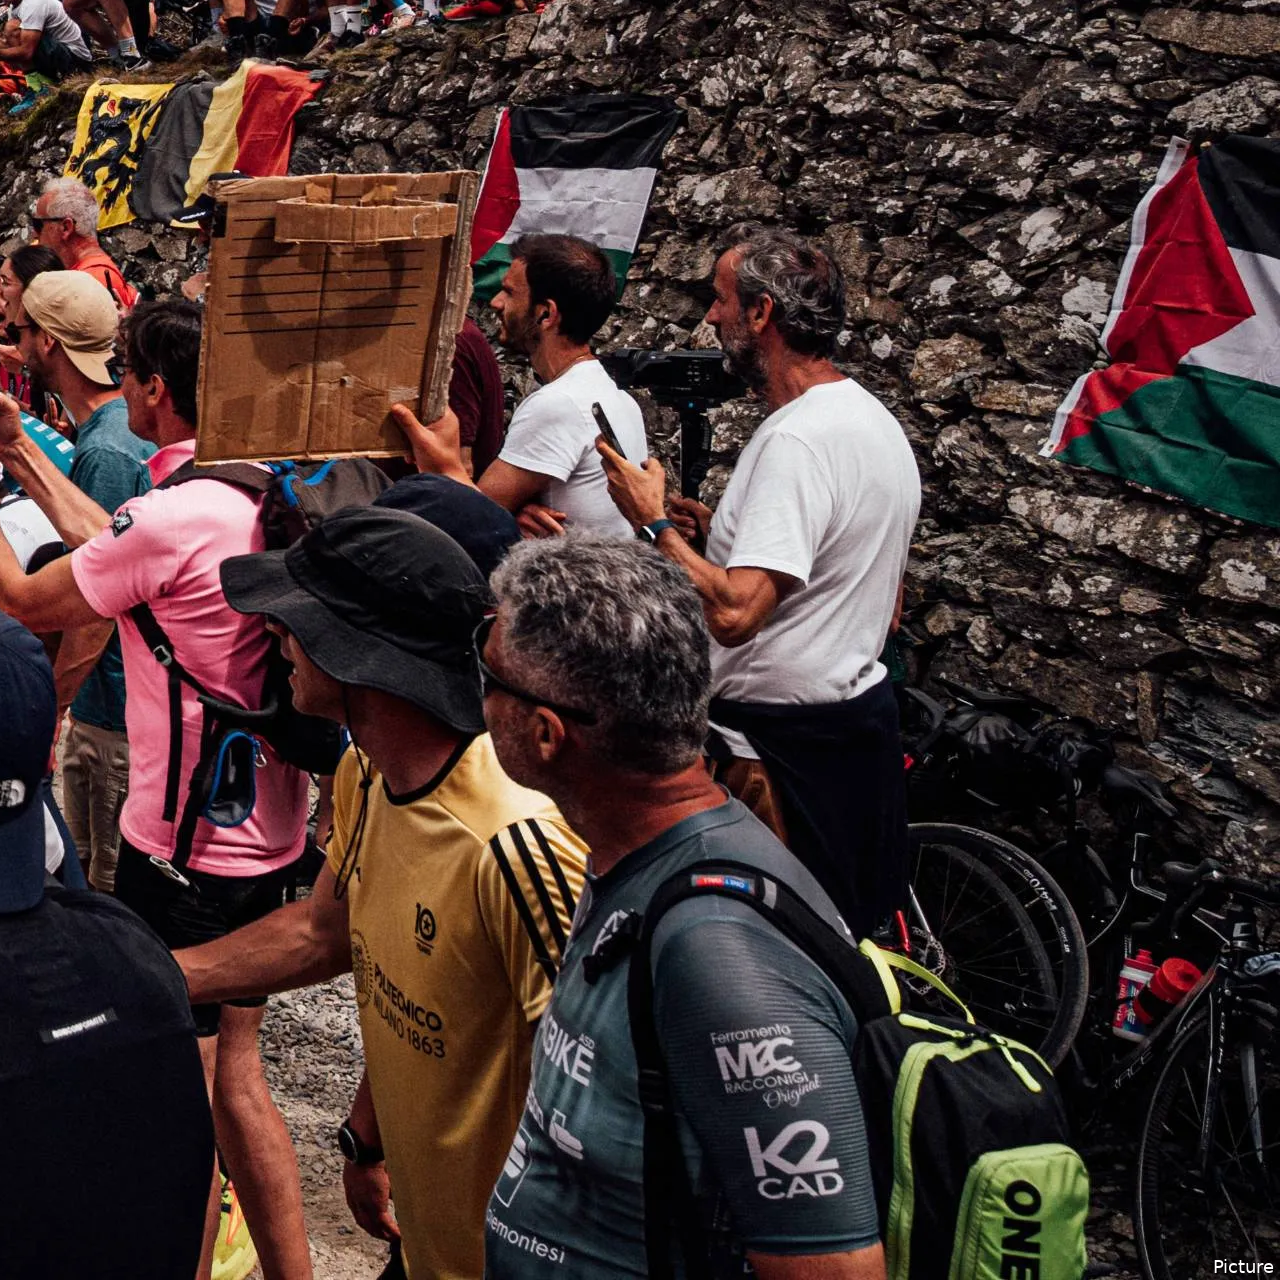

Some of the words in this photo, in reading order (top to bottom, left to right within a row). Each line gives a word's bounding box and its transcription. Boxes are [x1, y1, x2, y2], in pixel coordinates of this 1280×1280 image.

[407, 1026, 446, 1059] 1863
[709, 1023, 792, 1045] Ferramenta
[724, 1071, 810, 1095] RACCONIGI
[762, 1072, 821, 1109] Original
[743, 1120, 840, 1178] K2
[757, 1171, 845, 1200] CAD
